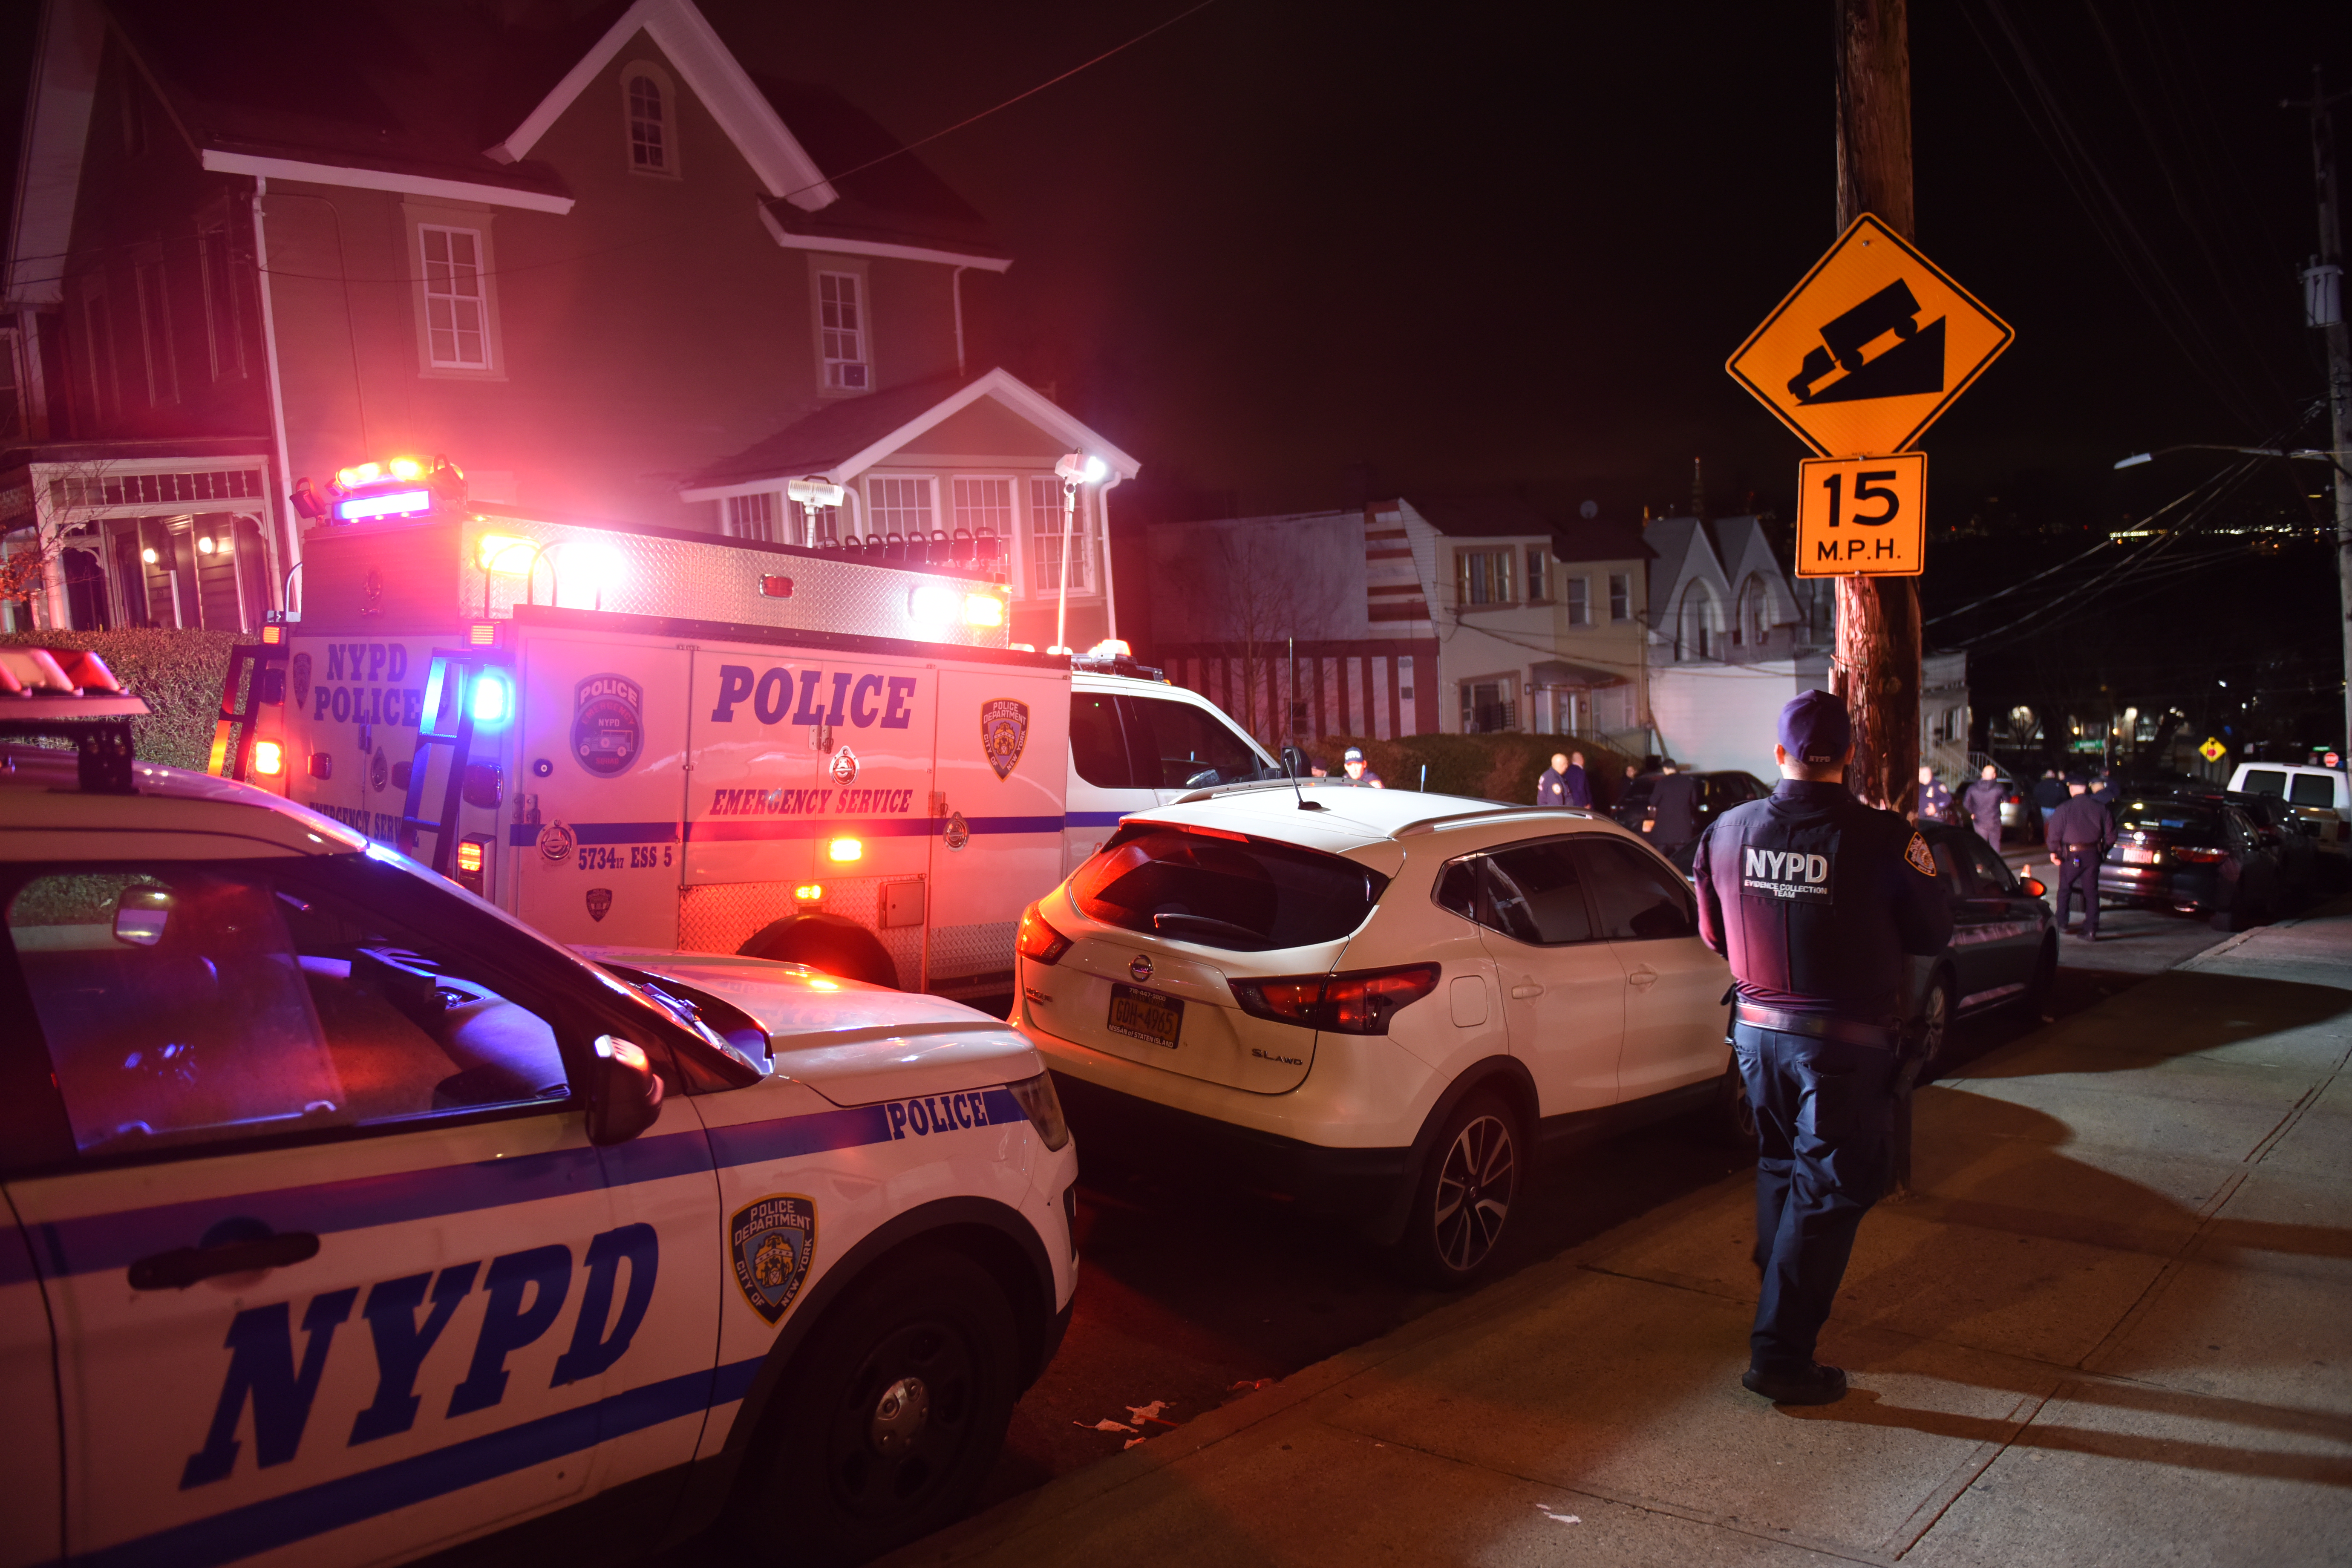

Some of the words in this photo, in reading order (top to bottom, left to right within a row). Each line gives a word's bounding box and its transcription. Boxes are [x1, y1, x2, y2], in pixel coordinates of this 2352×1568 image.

[1823, 470, 1899, 527] 15
[1818, 538, 1901, 561] M.P.H.
[327, 643, 407, 682] NYPD
[314, 686, 420, 727] POLICE
[580, 680, 637, 707] POLICE
[711, 665, 917, 729] POLICE
[993, 701, 1018, 712] POLICE
[581, 702, 634, 724] EMERGENCY
[598, 718, 620, 726] NYPD
[983, 710, 1026, 725] DEPARTMENT
[984, 734, 992, 753] CITY
[990, 756, 998, 766] OF
[1006, 753, 1017, 771] NEW
[1017, 730, 1026, 751] YORK
[709, 789, 832, 815] EMERGENCY
[836, 789, 913, 813] SERVICE
[579, 847, 616, 870] 5734
[631, 847, 657, 868] ESS
[664, 846, 672, 867] 5
[1746, 848, 1827, 883] NYPD
[1744, 879, 1779, 889] EVIDENCE
[1780, 884, 1827, 894] COLLECTION
[1773, 890, 1795, 898] TEAM
[1130, 987, 1166, 1001] 718-447-3800
[1109, 1024, 1127, 1035] NISSAN
[1134, 1032, 1153, 1042] STATEN
[1154, 1038, 1173, 1048] ISLAND
[887, 1092, 988, 1140] POLICE
[750, 1201, 795, 1222] POLICE
[735, 1214, 810, 1246] DEPARTMENT
[736, 1260, 753, 1289] CITY
[751, 1292, 765, 1306] OF
[781, 1279, 799, 1307] NEW
[798, 1238, 812, 1273] YORK
[179, 1222, 659, 1491] NYPD
